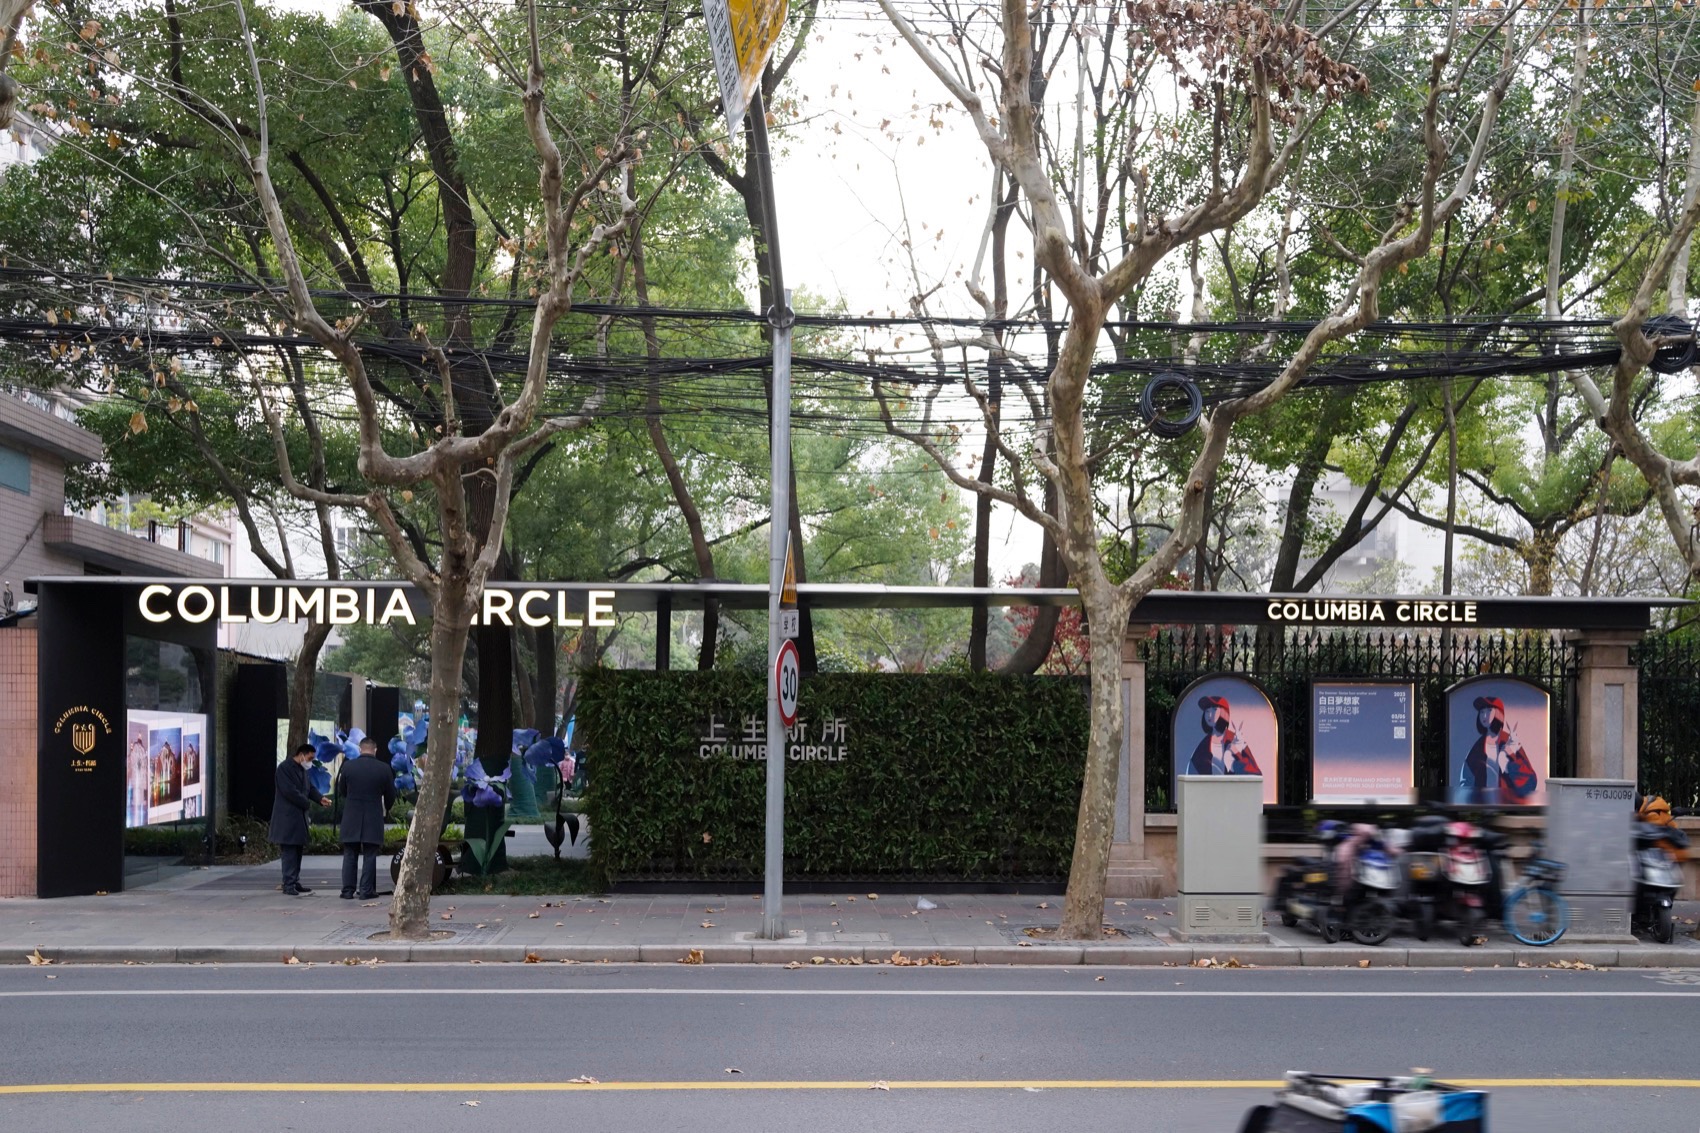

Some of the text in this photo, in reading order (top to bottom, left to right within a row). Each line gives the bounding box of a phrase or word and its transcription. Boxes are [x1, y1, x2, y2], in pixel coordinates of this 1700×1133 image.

[138, 584, 616, 627] COLUMBIA RCLE
[1267, 602, 1477, 622] COLUMBIA CIRCLE
[782, 665, 797, 702] 30
[54, 705, 112, 734] COLUMBIA CIRCLE
[790, 744, 848, 761] CIRCLE
